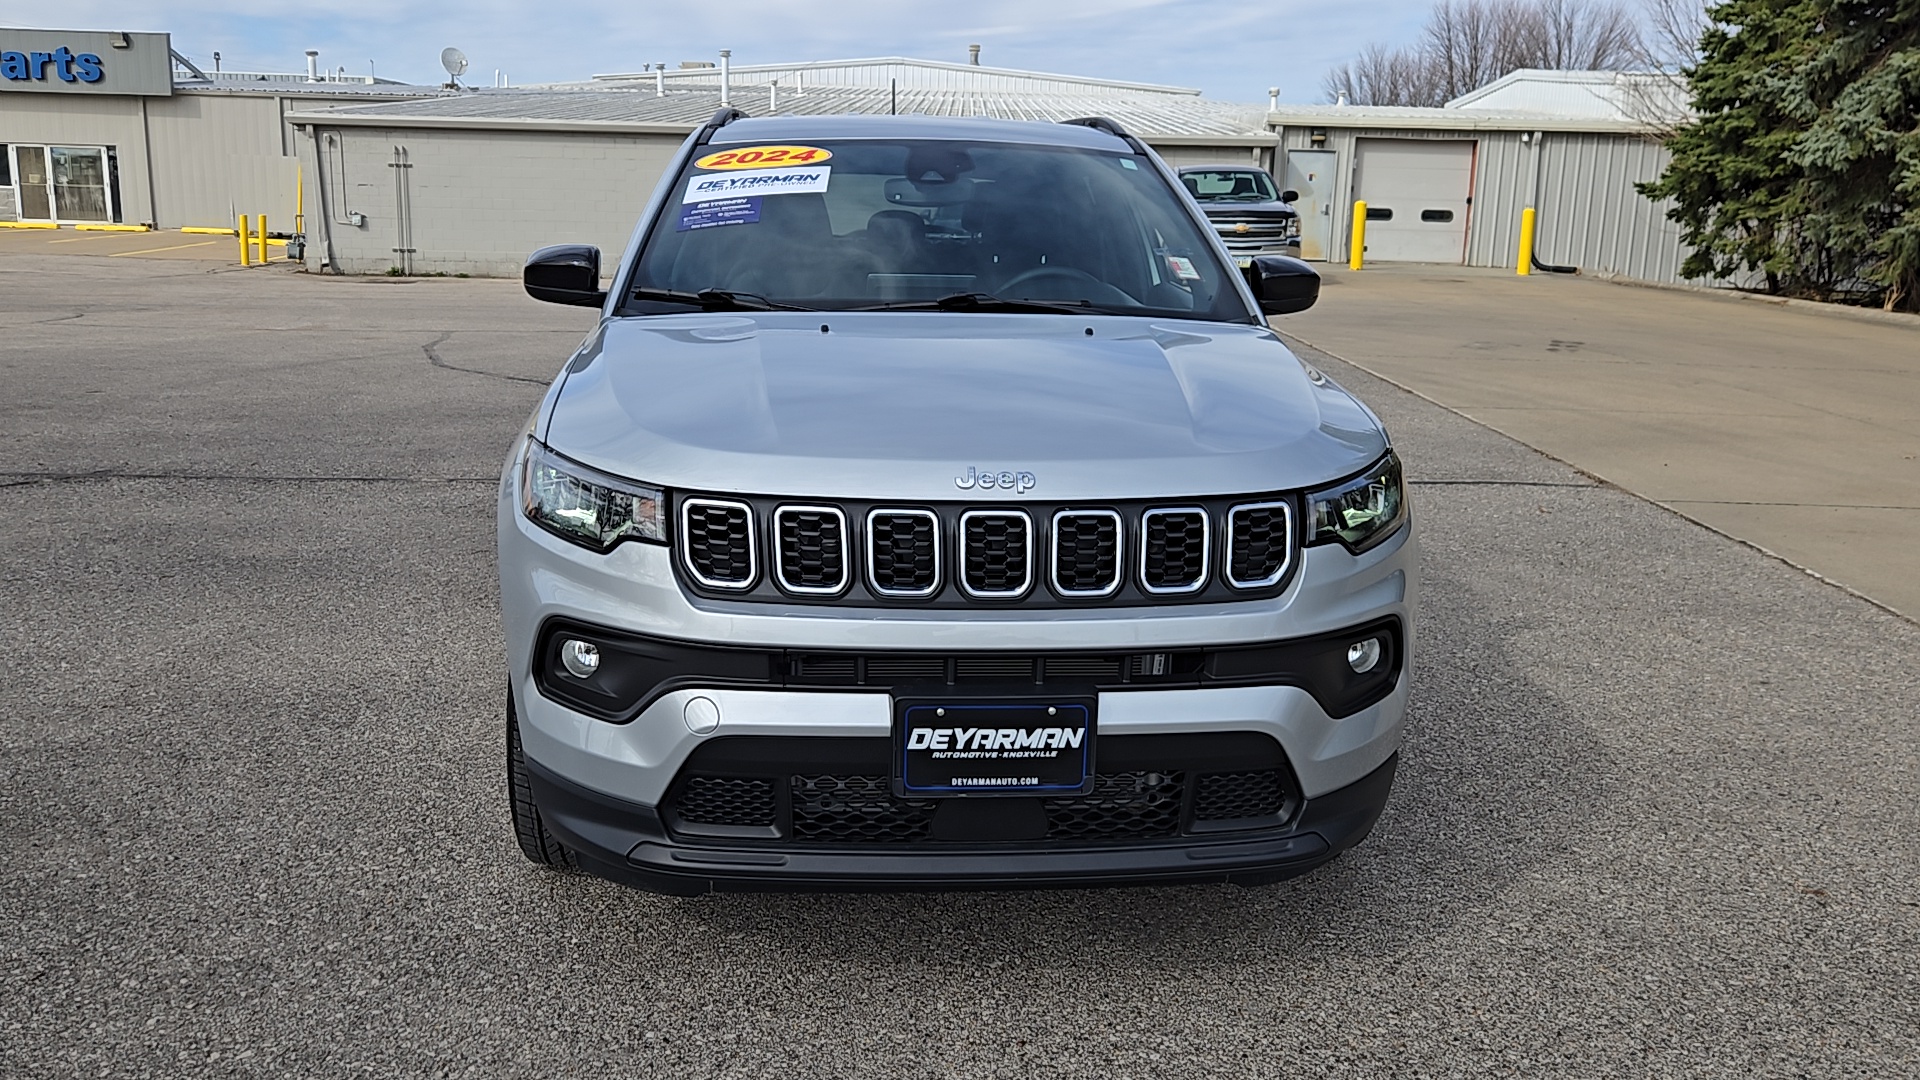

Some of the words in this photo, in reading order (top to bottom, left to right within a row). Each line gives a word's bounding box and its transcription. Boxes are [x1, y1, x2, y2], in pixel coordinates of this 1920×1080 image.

[0, 46, 102, 82] arts
[707, 149, 819, 167] 2024
[696, 174, 821, 191] DEYARMAN
[704, 184, 755, 193] CERTIFIED
[954, 466, 1036, 494] Jeep
[907, 728, 1086, 750] DEYARMAN
[951, 777, 1039, 786] DEYARMANAUTO.COM
